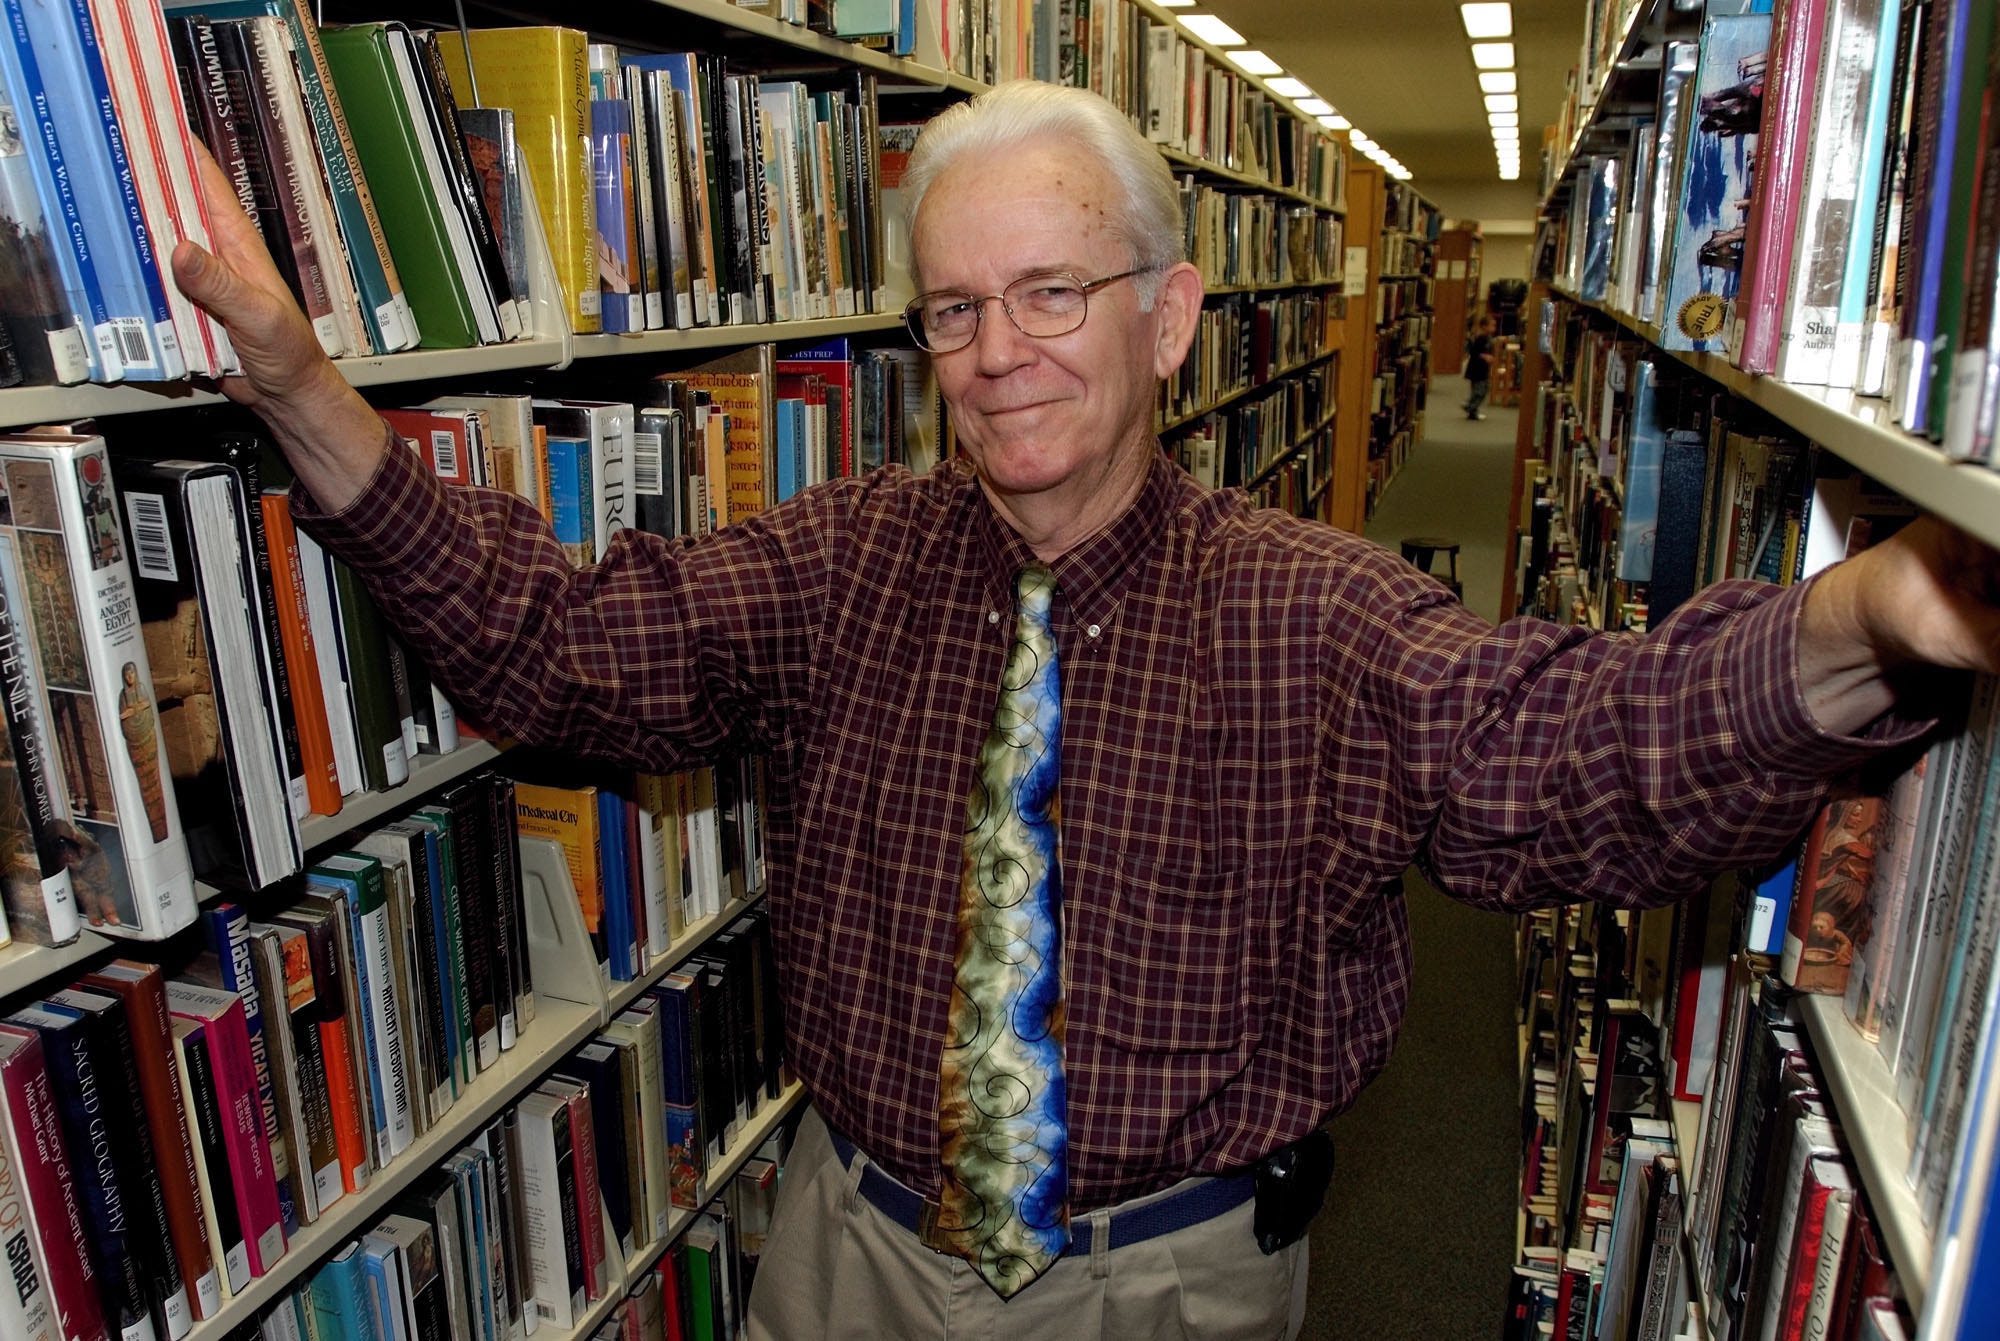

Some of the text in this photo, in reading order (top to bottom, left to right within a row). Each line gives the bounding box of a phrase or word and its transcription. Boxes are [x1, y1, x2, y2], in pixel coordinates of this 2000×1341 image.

[14, 14, 28, 42] SERIES
[80, 16, 94, 46] SERIES
[197, 24, 231, 116] MUMMIES
[572, 40, 586, 99] Michael
[225, 120, 234, 131] OF
[229, 137, 240, 156] THE
[309, 94, 332, 152] ANCIENT
[329, 156, 346, 193] EGYPT
[310, 73, 338, 147] HANDBOOK
[336, 151, 346, 167] TO
[326, 87, 350, 143] ANCIENT
[344, 146, 364, 187] EGYPT
[35, 91, 89, 260] THE GREAT WALL OF CHINA
[100, 96, 152, 263] THE GREAT WALL OF CHINA
[579, 153, 592, 229] The Ancient
[364, 202, 391, 269] ROSALIE DAVID
[1868, 246, 1881, 296] HISTORY
[1691, 304, 1715, 332] TRUE
[247, 463, 259, 494] What
[251, 499, 262, 521] Life
[255, 522, 265, 547] Was
[1794, 497, 1810, 575] Your Guide
[96, 597, 131, 619] ANCIENT
[103, 611, 131, 631] EGYPT
[295, 592, 303, 619] PYRAMID
[0, 633, 19, 674] THE
[7, 674, 29, 722] NILE
[22, 732, 51, 824] JOHN ROMER
[515, 804, 578, 825] Medieval City
[227, 916, 264, 1017] Masada
[450, 885, 471, 1025] CELTIC WARRIOR CHIEFS
[307, 1023, 320, 1052] DAILY
[374, 913, 408, 1113] DAILY LIFE IN ANCIENT MESOPOTAMI
[312, 1053, 323, 1075] LIFE
[316, 1075, 324, 1085] IN
[23, 1082, 50, 1163] Michael Grant
[70, 1038, 128, 1231] SACRED GEOGRAPHY
[233, 1099, 248, 1133] JESUS
[238, 1094, 266, 1178] JEWISH PEOPLE
[316, 1087, 332, 1126] ANCIENT
[165, 1049, 208, 1241] A History of Israel and the Holy Land
[323, 1128, 336, 1155] INDIA
[580, 1122, 597, 1217] MARK ANTONY
[34, 1071, 93, 1280] The History of Ancient Israel
[1, 1201, 40, 1305] OF ISRAEL
[1812, 1234, 1839, 1307] HAVING
